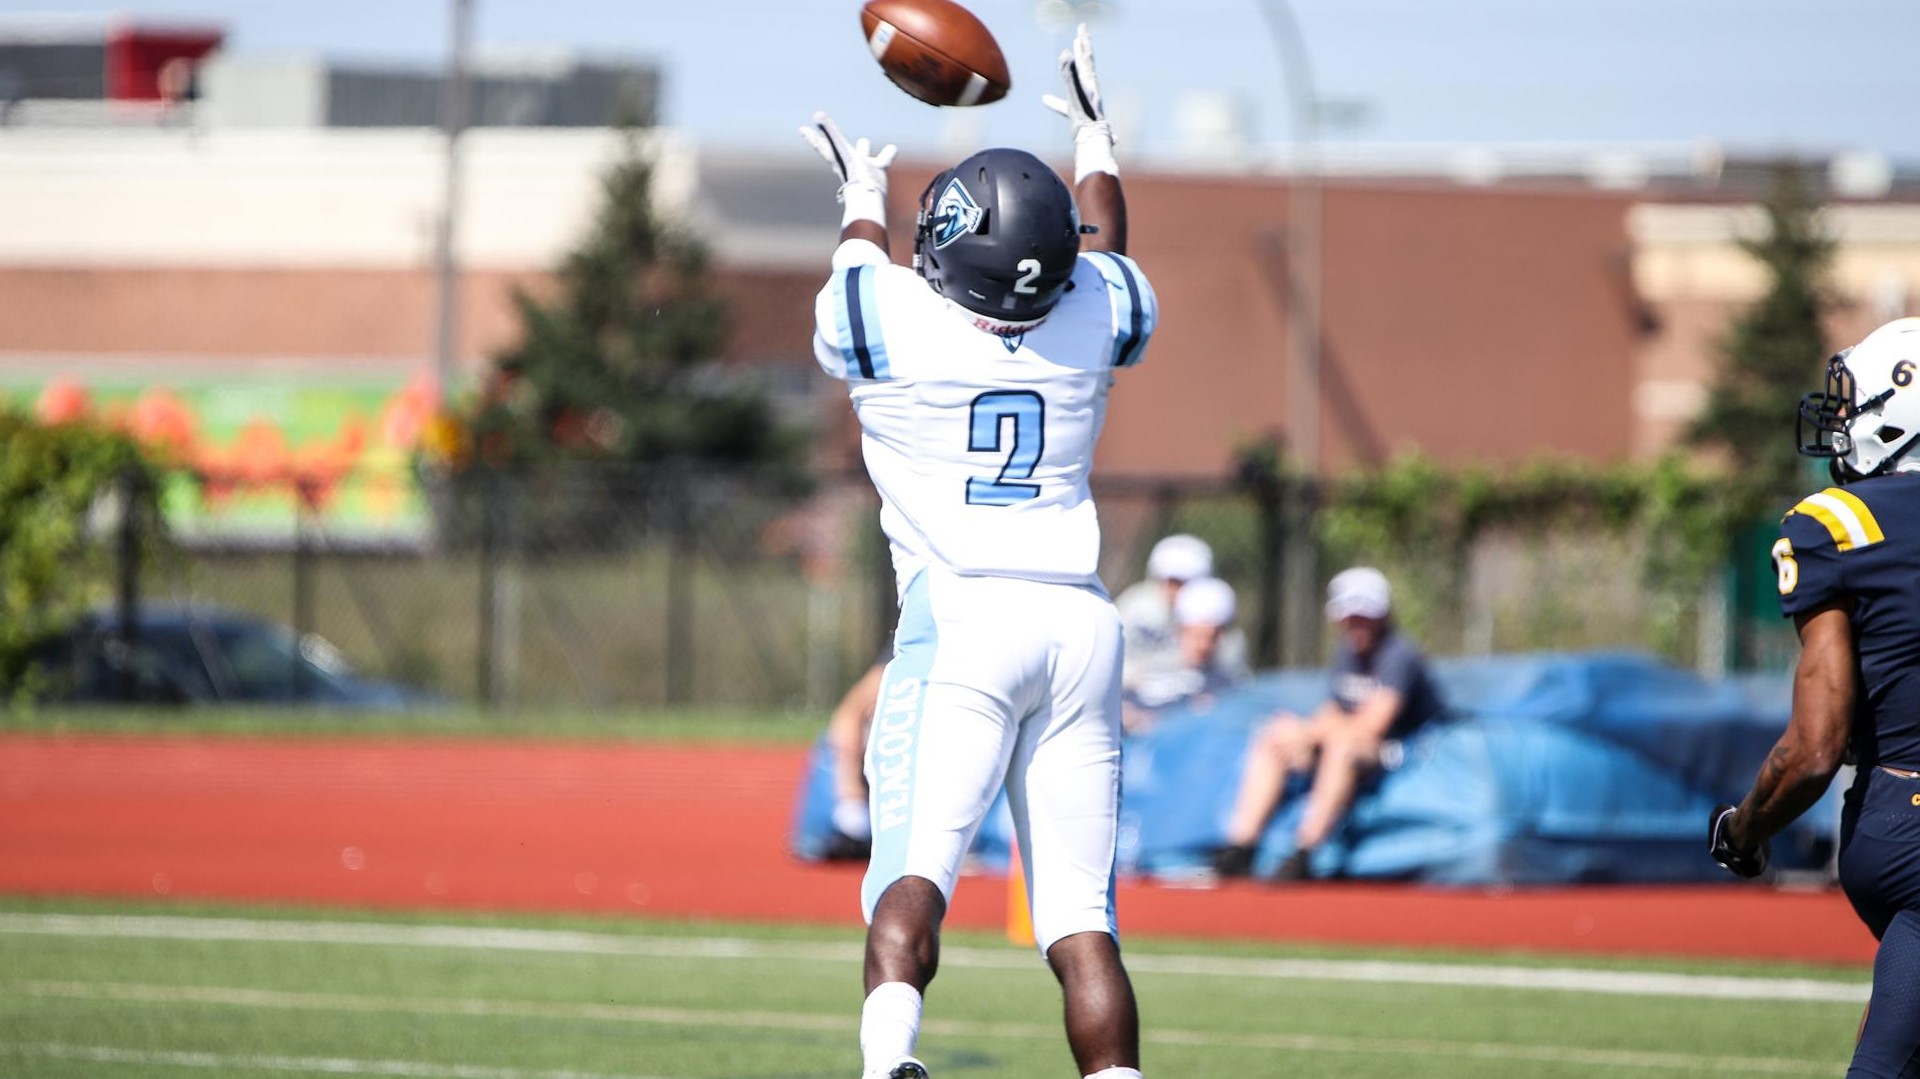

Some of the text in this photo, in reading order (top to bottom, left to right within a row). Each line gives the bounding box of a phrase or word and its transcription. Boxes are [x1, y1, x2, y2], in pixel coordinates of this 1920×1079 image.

[1014, 258, 1041, 294] 2
[1891, 359, 1917, 388] 6
[965, 389, 1045, 507] 2
[1771, 537, 1798, 595] 6
[879, 676, 921, 831] PEACOCKS
